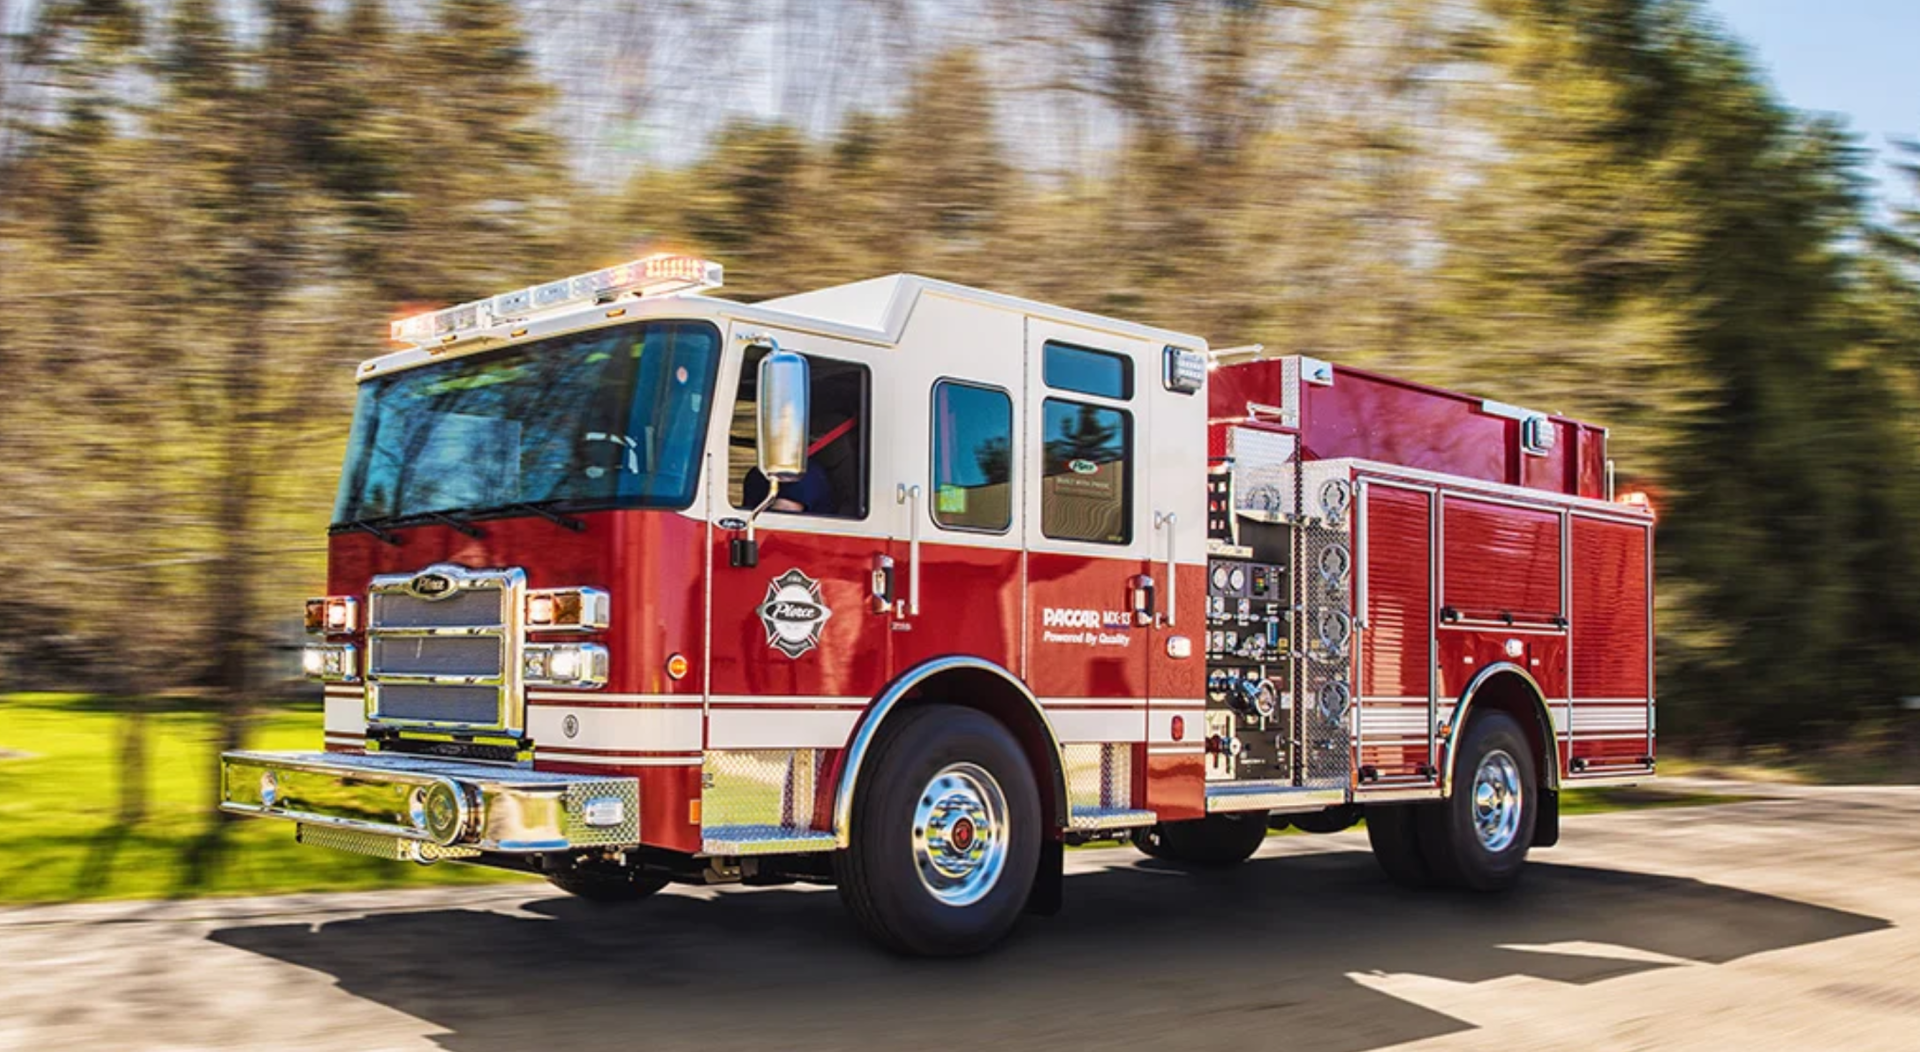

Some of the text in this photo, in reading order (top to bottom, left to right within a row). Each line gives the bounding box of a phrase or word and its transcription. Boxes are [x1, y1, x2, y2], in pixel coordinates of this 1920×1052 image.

[772, 603, 815, 618] Pierce
[1043, 608, 1130, 628] PACCAR MX-13
[1043, 631, 1130, 647] Powered By Quality
